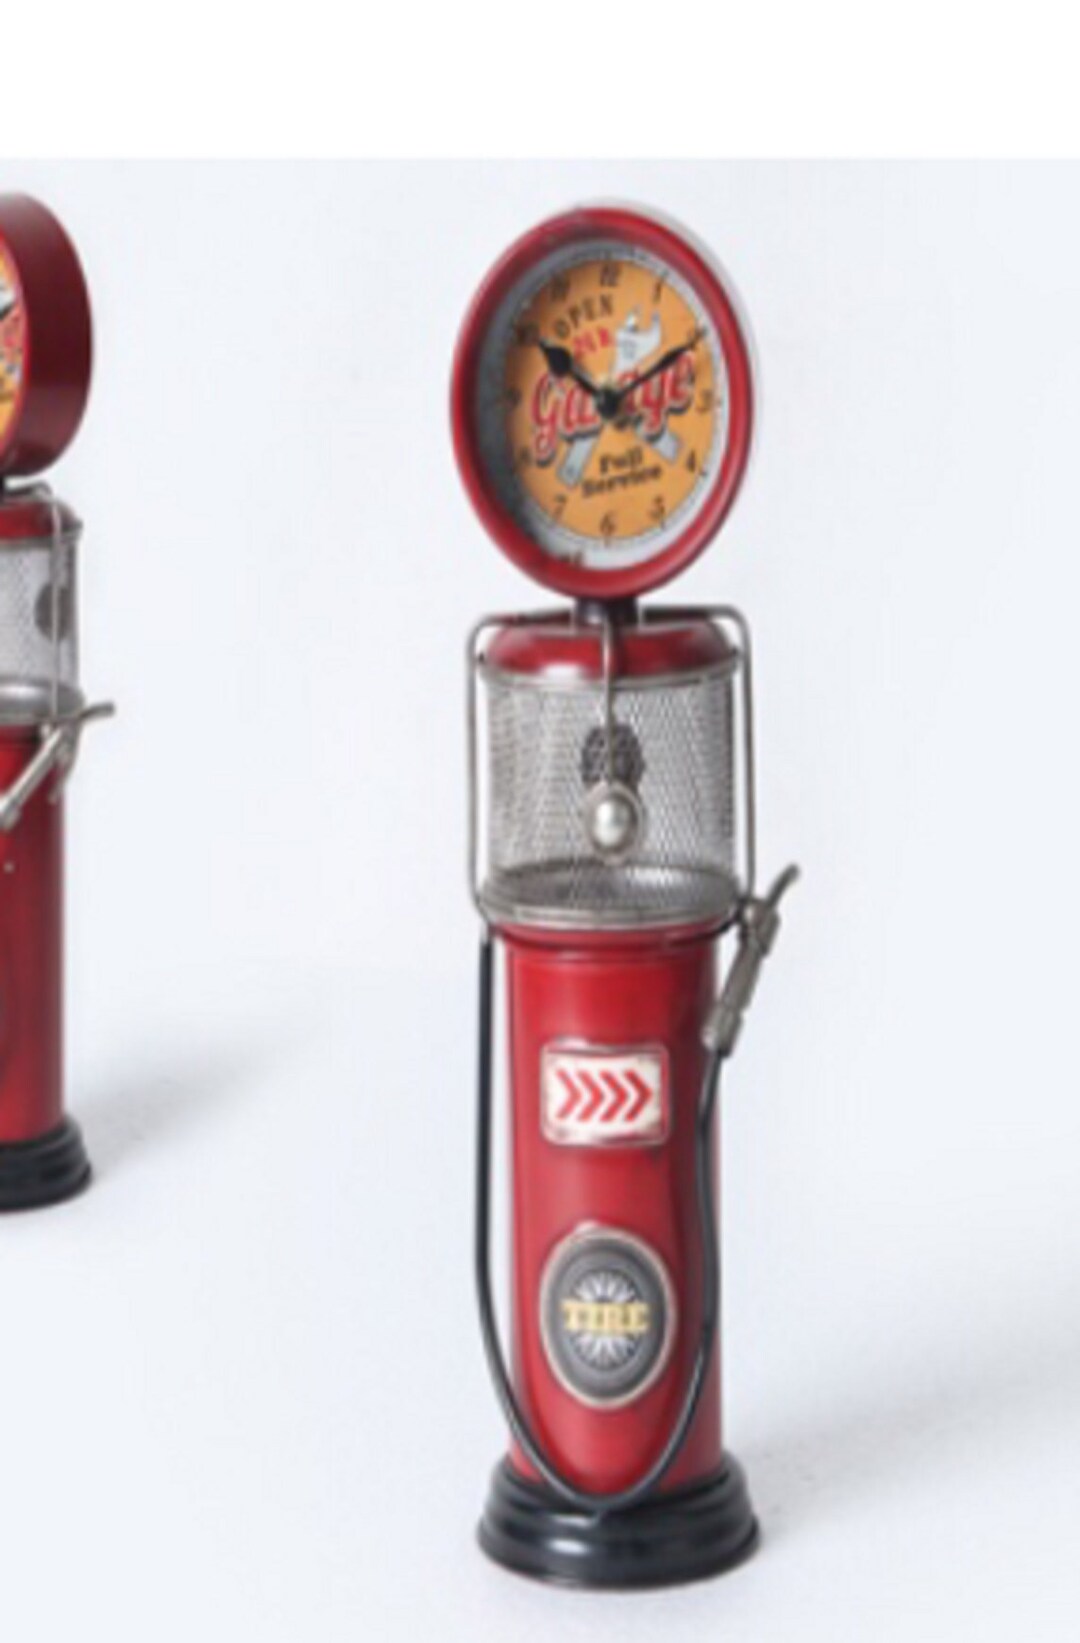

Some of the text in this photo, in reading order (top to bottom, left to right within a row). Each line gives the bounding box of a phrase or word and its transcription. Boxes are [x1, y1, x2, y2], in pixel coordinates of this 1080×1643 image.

[553, 293, 613, 339] OPEN
[531, 351, 696, 467] Gaage
[599, 446, 643, 476] Full
[685, 449, 697, 475] 4
[581, 465, 663, 499] Service
[599, 510, 617, 539] 6
[561, 1300, 649, 1335] TIRE
